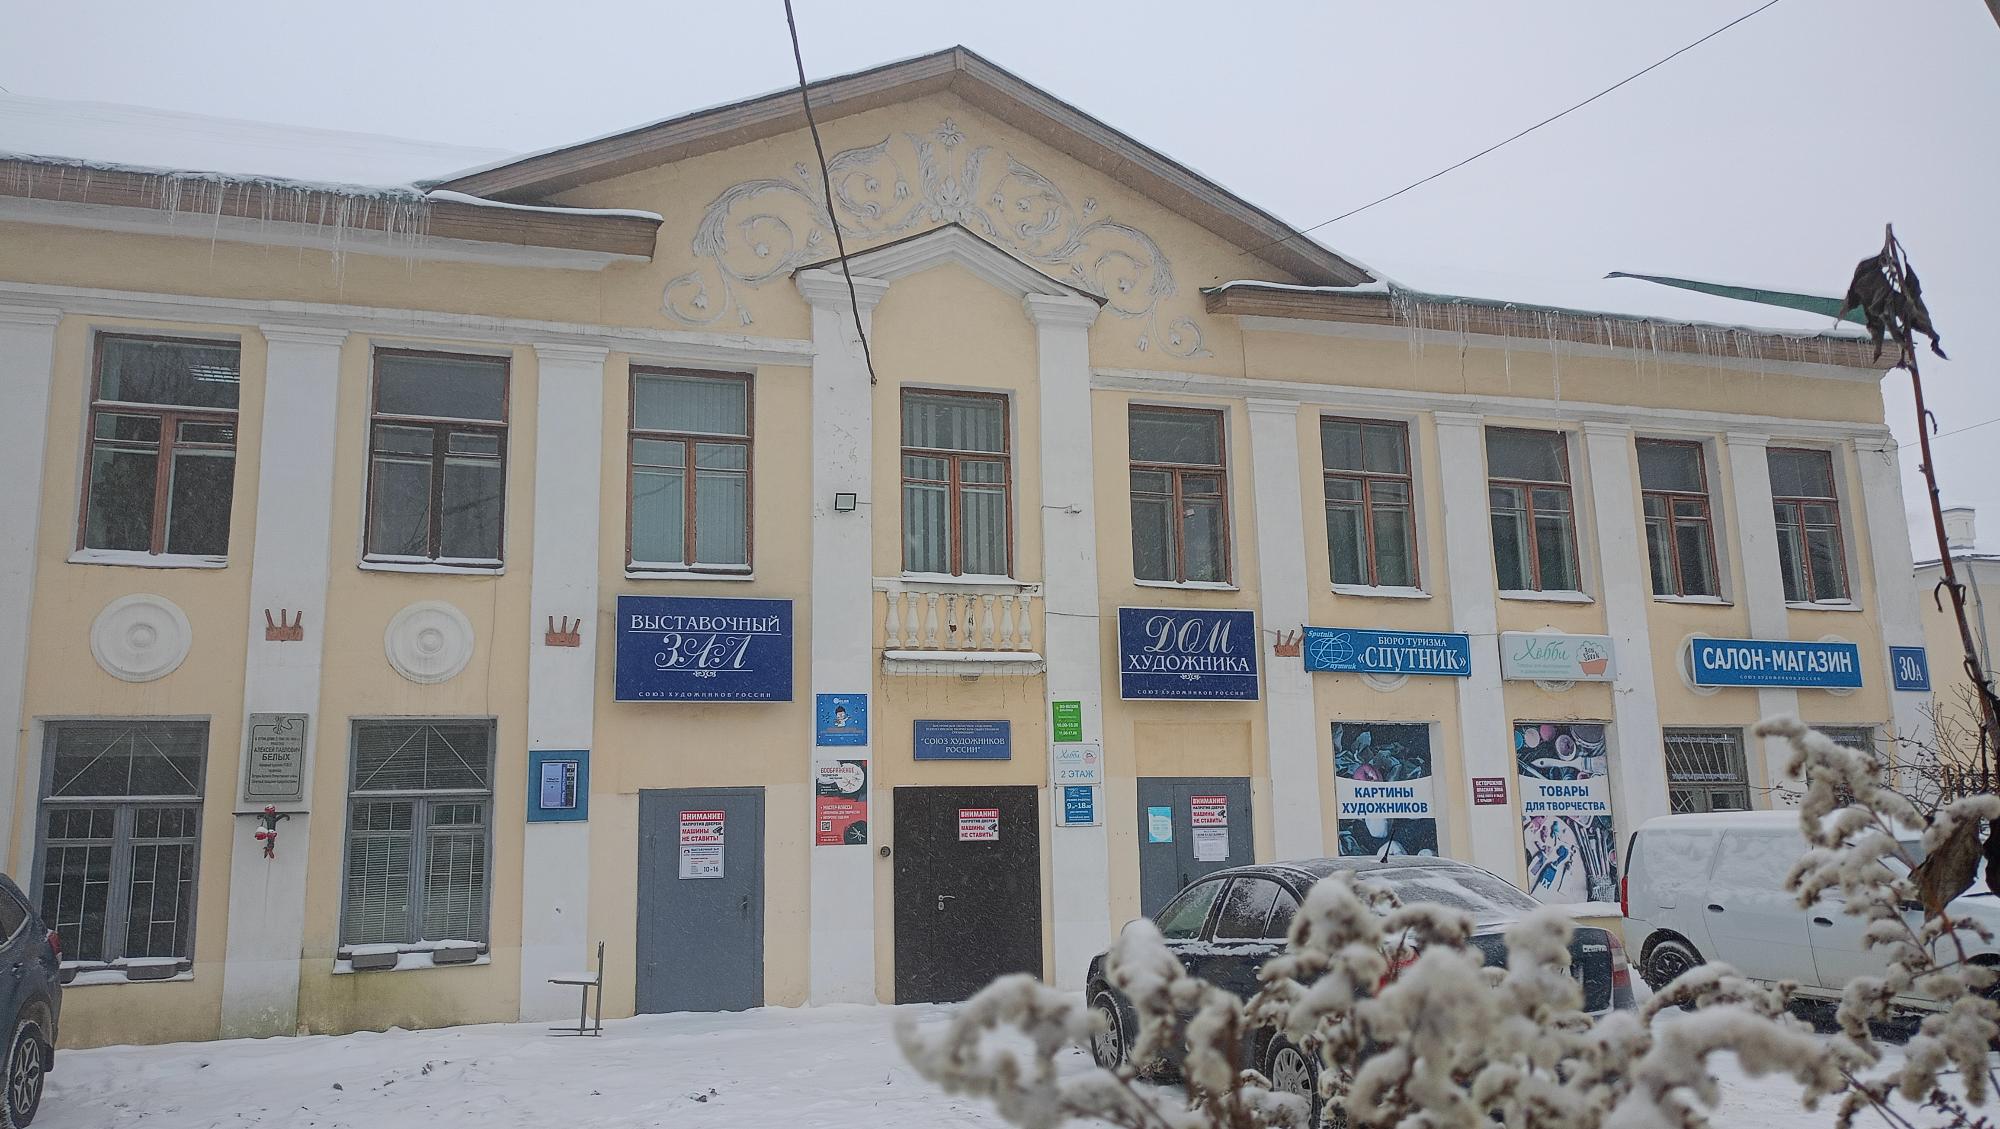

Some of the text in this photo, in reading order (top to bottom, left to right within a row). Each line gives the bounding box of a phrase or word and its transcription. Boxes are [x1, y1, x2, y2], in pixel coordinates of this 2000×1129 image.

[631, 614, 780, 632] ВЫСТАВОЧНЫЙ
[1144, 616, 1234, 654] ДОМ
[1308, 630, 1334, 638] Sputnik
[1379, 636, 1447, 647] БЮРО ТУРИЗМА
[654, 633, 752, 669] ЗАЛ
[1514, 638, 1569, 660] Хобби
[1128, 654, 1250, 672] ХУДОЖНИКА
[1357, 646, 1467, 672] «СПУТНИК»
[1703, 647, 1852, 673] САЛОН-МАГАЗИН
[668, 691, 732, 699] ХУДОЖНИКОВ
[950, 738, 1005, 746] ХУДОЖНИКОВ
[1061, 769, 1094, 778] 2 ЭТАЖ
[1354, 787, 1414, 798] КАРТИНЫ
[1539, 786, 1589, 796] ТОВАРЫ
[1342, 802, 1428, 815] ХУДОЖНИКОВ
[1525, 802, 1606, 812] ДЛЯ ТВОРЧЕСТВА
